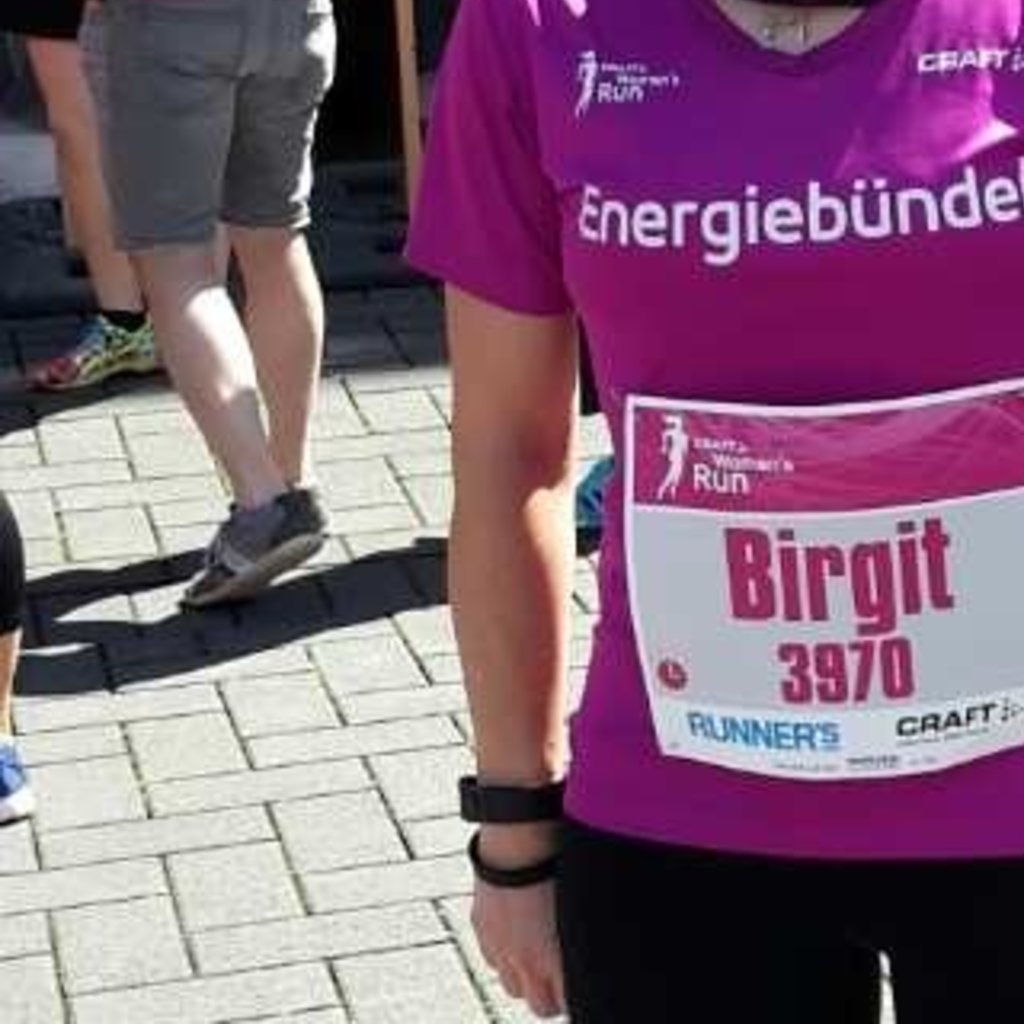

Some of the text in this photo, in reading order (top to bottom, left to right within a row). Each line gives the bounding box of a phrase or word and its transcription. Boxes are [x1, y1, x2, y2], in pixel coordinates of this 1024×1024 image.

[918, 49, 1009, 72] CRAFT
[598, 81, 644, 103] Run
[693, 462, 750, 494] Run
[723, 517, 955, 637] Birgit
[778, 637, 915, 705] 3970
[687, 711, 840, 750] RUNNER'S
[896, 702, 997, 737] CRAFT
